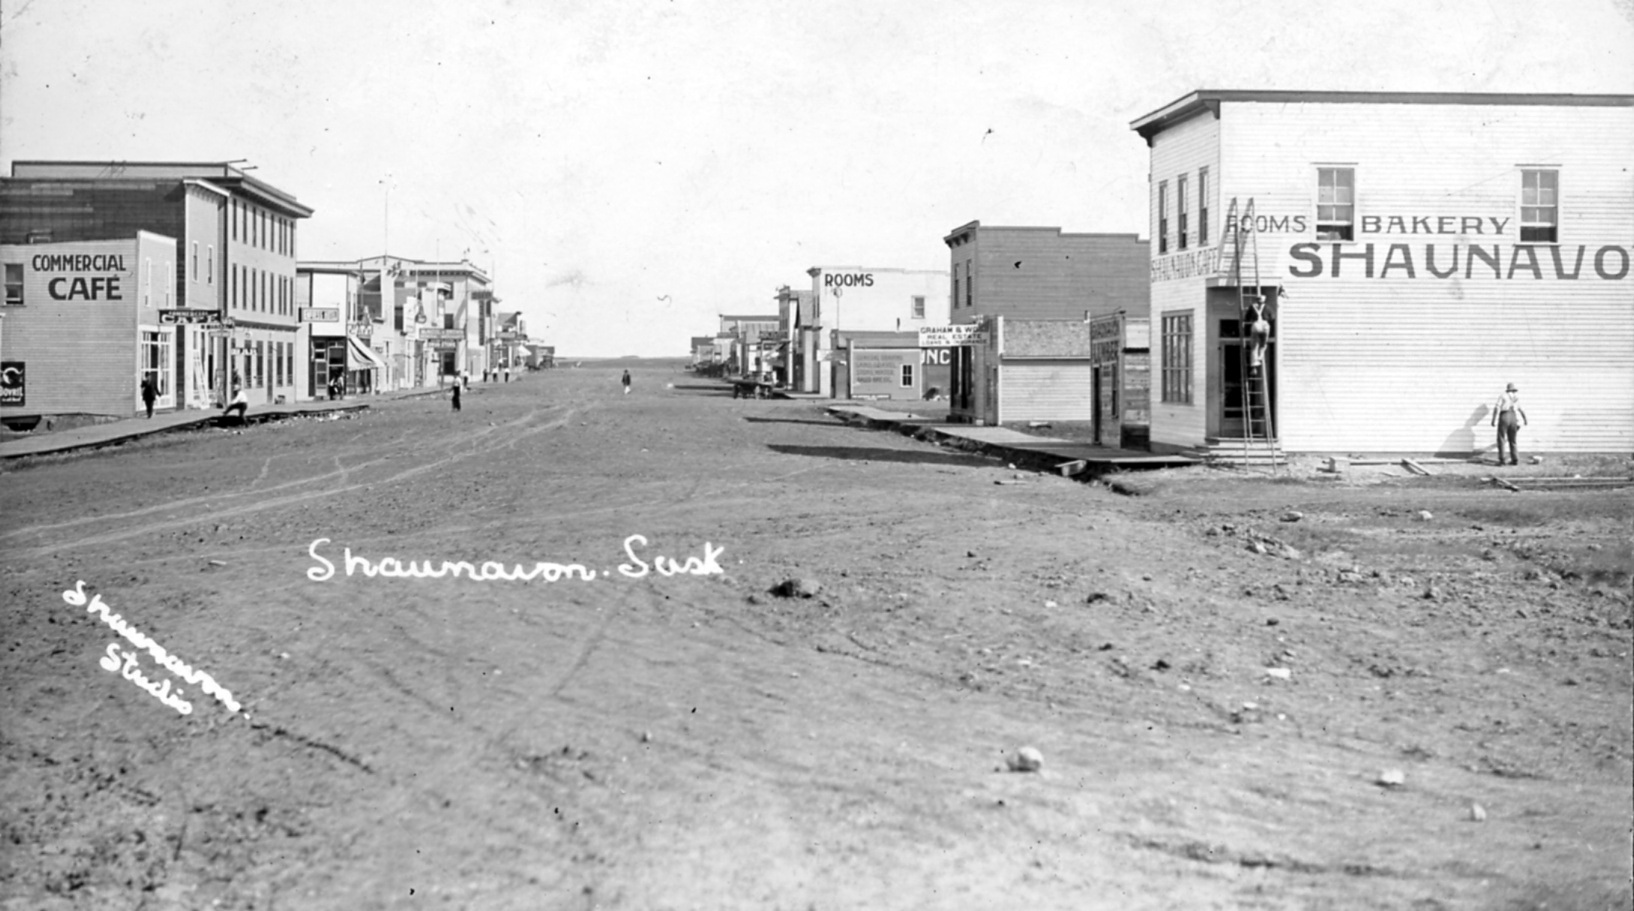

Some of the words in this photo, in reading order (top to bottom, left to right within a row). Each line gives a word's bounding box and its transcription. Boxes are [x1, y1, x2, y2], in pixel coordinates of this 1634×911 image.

[1226, 215, 1307, 233] ROOMS
[1361, 215, 1511, 235] BAKERY
[32, 254, 126, 272] COMMERCIAL
[1289, 242, 1630, 280] SHAUNAVO
[48, 274, 123, 300] CAFÉ
[825, 273, 874, 287] ROOMS
[920, 326, 953, 334] GRAHAM
